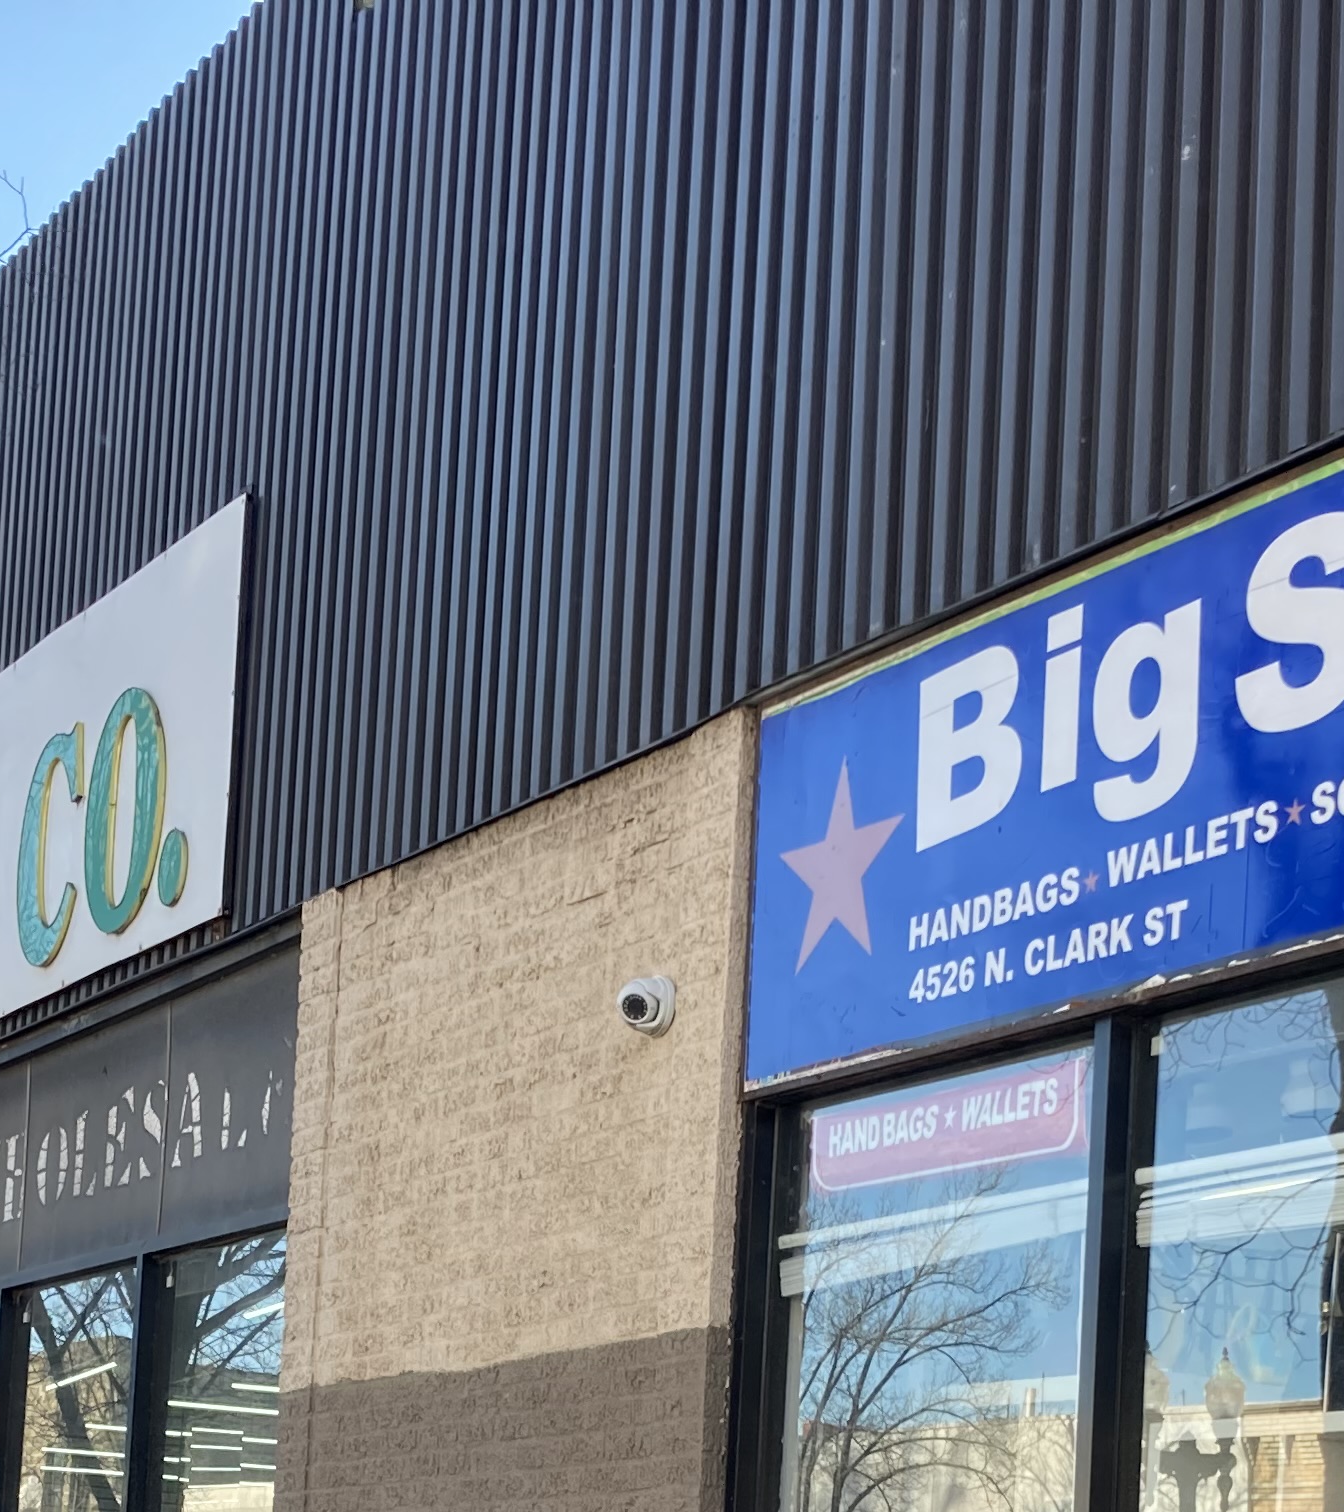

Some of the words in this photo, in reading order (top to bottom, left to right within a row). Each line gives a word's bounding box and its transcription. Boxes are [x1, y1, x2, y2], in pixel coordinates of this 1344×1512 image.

[915, 598, 1202, 852] Big
[15, 686, 189, 969] CO.
[908, 866, 1081, 953] HANDBAGS
[1106, 799, 1279, 888] WALLETS
[908, 949, 976, 1005] 4526
[984, 943, 1015, 988] N.
[1024, 910, 1134, 977] CLARK
[1144, 898, 1190, 944] ST
[961, 1077, 1059, 1132] WALLETS
